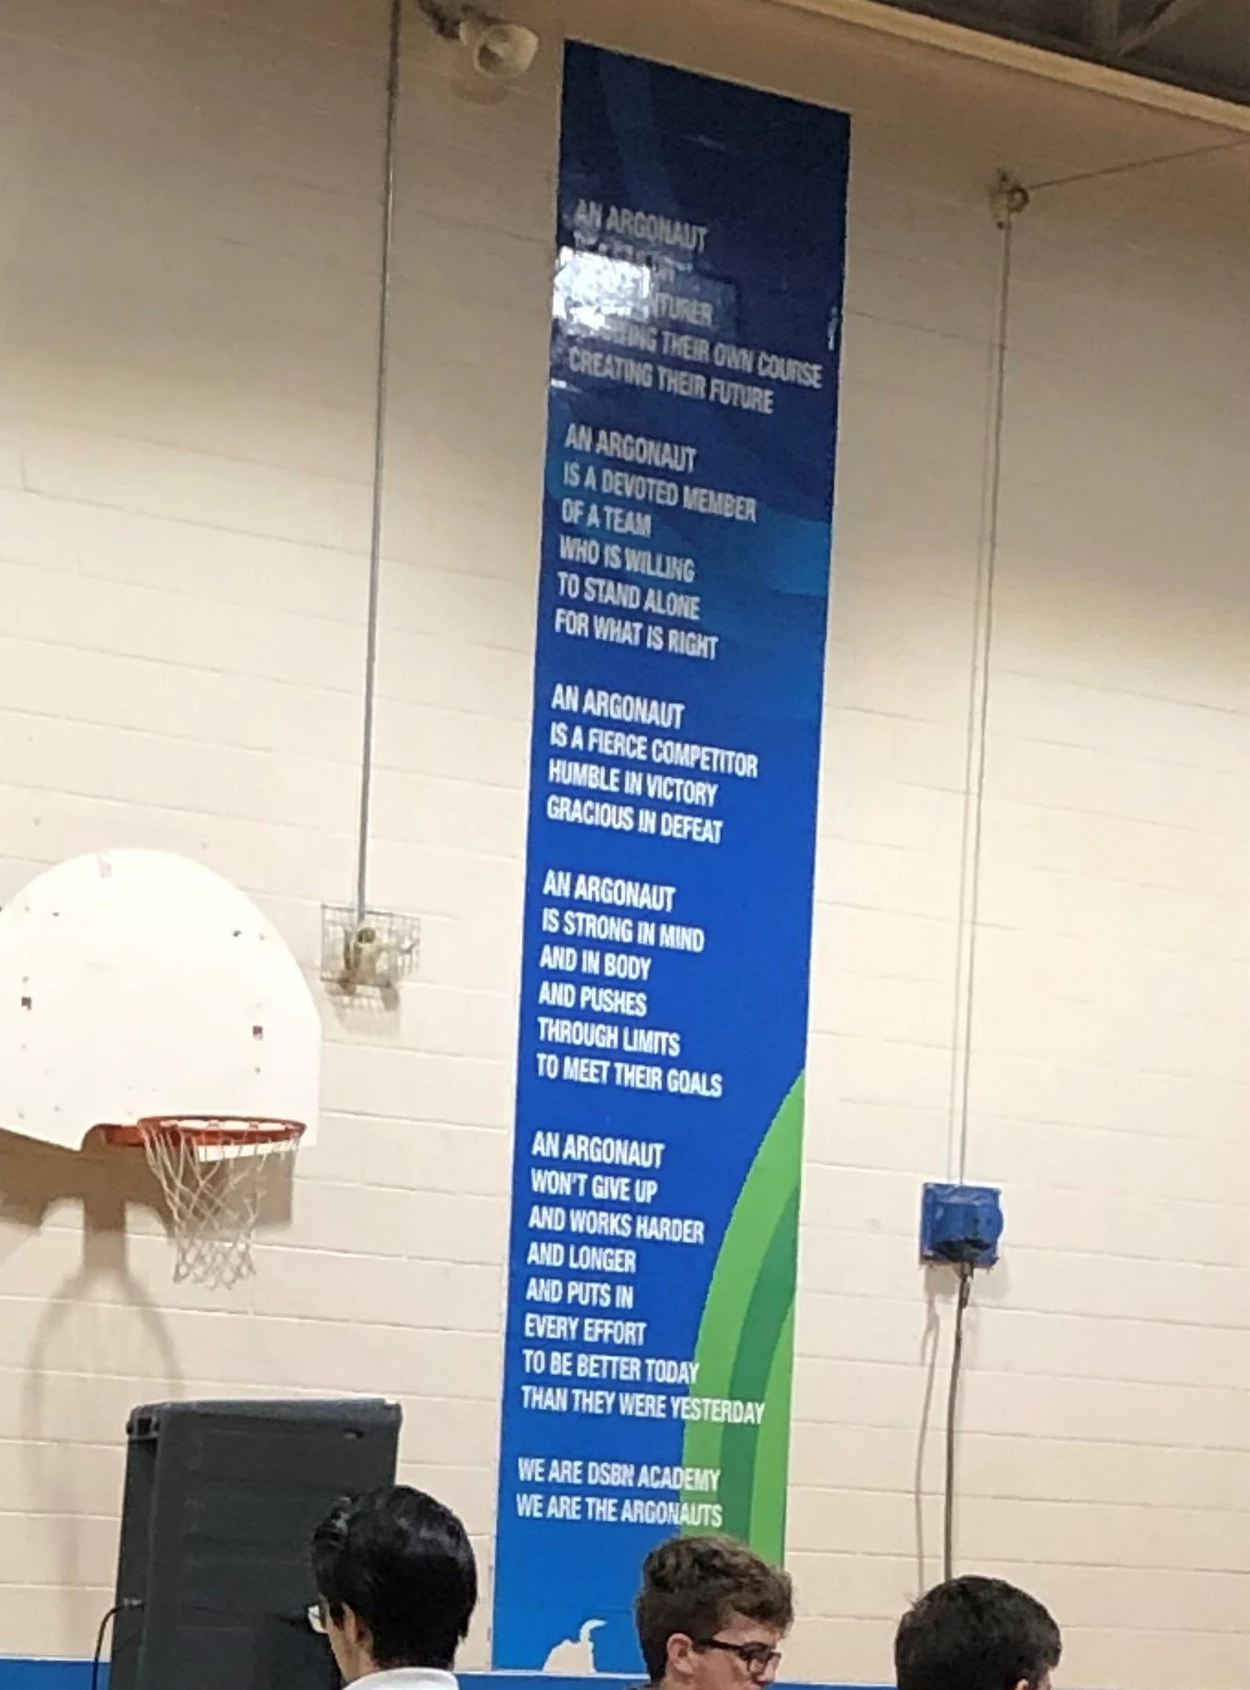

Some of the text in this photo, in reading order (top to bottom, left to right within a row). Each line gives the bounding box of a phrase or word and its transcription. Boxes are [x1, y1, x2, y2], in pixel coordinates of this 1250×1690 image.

[575, 199, 707, 252] AN ARGONAUT
[570, 347, 774, 413] CREATING THEIR FUTURE
[662, 331, 710, 360] THEIR
[714, 343, 752, 373] OWN
[758, 352, 822, 389] COURSE
[565, 423, 696, 472] AN ARGONAUT
[564, 462, 756, 522] IS A DEVOTED MEMBER
[562, 498, 651, 538] OF A TEAM
[560, 534, 695, 583] WHO IS WILLING
[558, 571, 700, 620] TO STAND ALONE
[555, 609, 718, 660] FOR WHAT IS RIGHT
[551, 683, 685, 730] AN ARGONAUT
[550, 721, 758, 778] IS A FIERCE COMPETITOR
[549, 758, 719, 807] HUMBLE IN VICTORY
[547, 794, 723, 845] GRACIOUS IN DEFEAT
[543, 869, 676, 912] AN ARGONAUT
[542, 908, 705, 953] IS STRONG IN MIND
[540, 944, 651, 981] AND IN BODY
[538, 981, 647, 1017] AND PUSHES
[537, 1017, 680, 1057] THROUGH LIMITS
[536, 1053, 723, 1098] TO MEET THEIR GOALS
[531, 1131, 665, 1169] AN ARGONAUT
[531, 1168, 658, 1203] WON'T GIVE UP
[529, 1205, 705, 1244] AND WORKS HARDER
[527, 1242, 636, 1273] AND LONGER
[526, 1278, 634, 1309] AND PUTS IN
[524, 1313, 647, 1346] EVERY EFFORT
[522, 1349, 699, 1385] TO BE BETTER TODAY
[522, 1386, 765, 1425] THAN THEY WERE YESTERDAY
[518, 1457, 721, 1491] WE ARE DSBN ACADEMY
[516, 1494, 722, 1527] WE ARE THE ARGONAUTS
